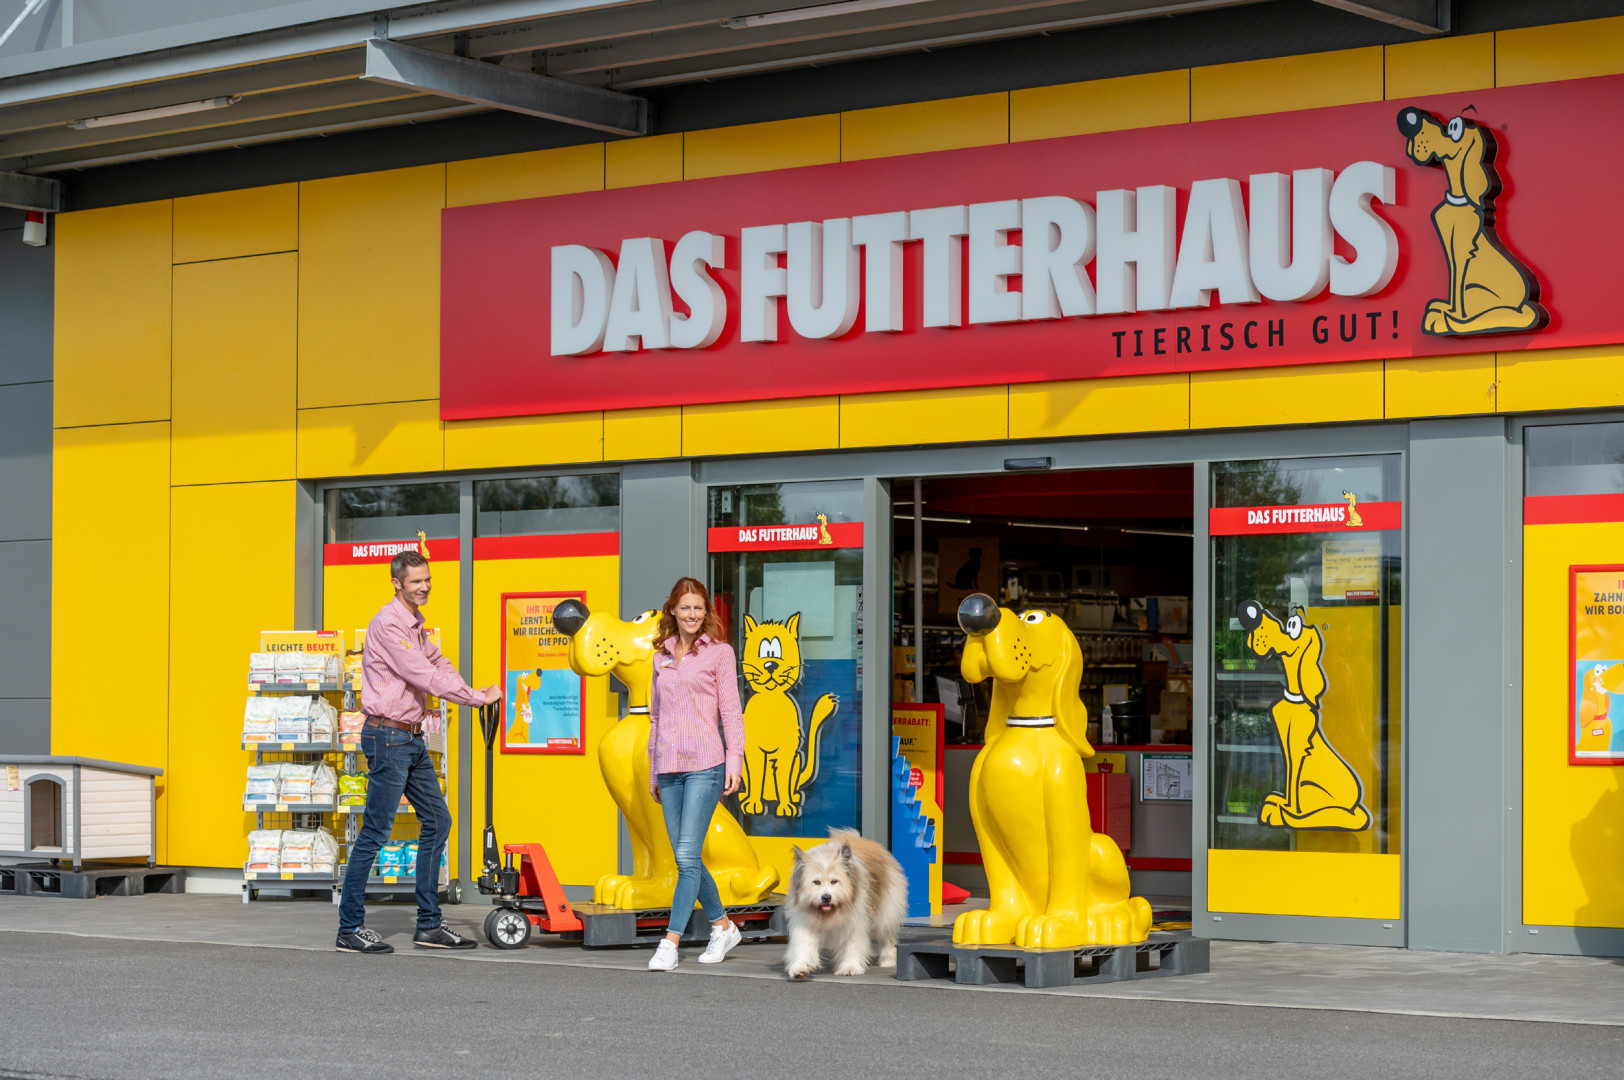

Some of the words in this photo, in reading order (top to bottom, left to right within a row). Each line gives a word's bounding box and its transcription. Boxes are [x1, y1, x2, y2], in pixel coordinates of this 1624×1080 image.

[551, 230, 727, 356] DAS
[741, 161, 1399, 342] FUTTERHAUS
[1112, 319, 1286, 358] TIERISCH
[1312, 310, 1399, 344] GUT!
[1248, 510, 1270, 525] DAS
[1272, 507, 1345, 523] FUTTERHAUS
[739, 529, 757, 543] DAS
[758, 527, 818, 541] FUTTERHAUS
[352, 545, 368, 558] DAS
[369, 543, 418, 557] FUTTERHAUS
[1594, 592, 1624, 602] ZAHN
[526, 605, 540, 614] IHR
[542, 604, 556, 614] TIE
[1585, 605, 1605, 615] WIR
[520, 616, 543, 625] LERNT
[513, 627, 527, 636] WIR
[538, 638, 551, 646] DIE
[552, 637, 570, 646] PFO
[266, 643, 304, 652] LEICHTE
[306, 643, 338, 651] BEUTE.
